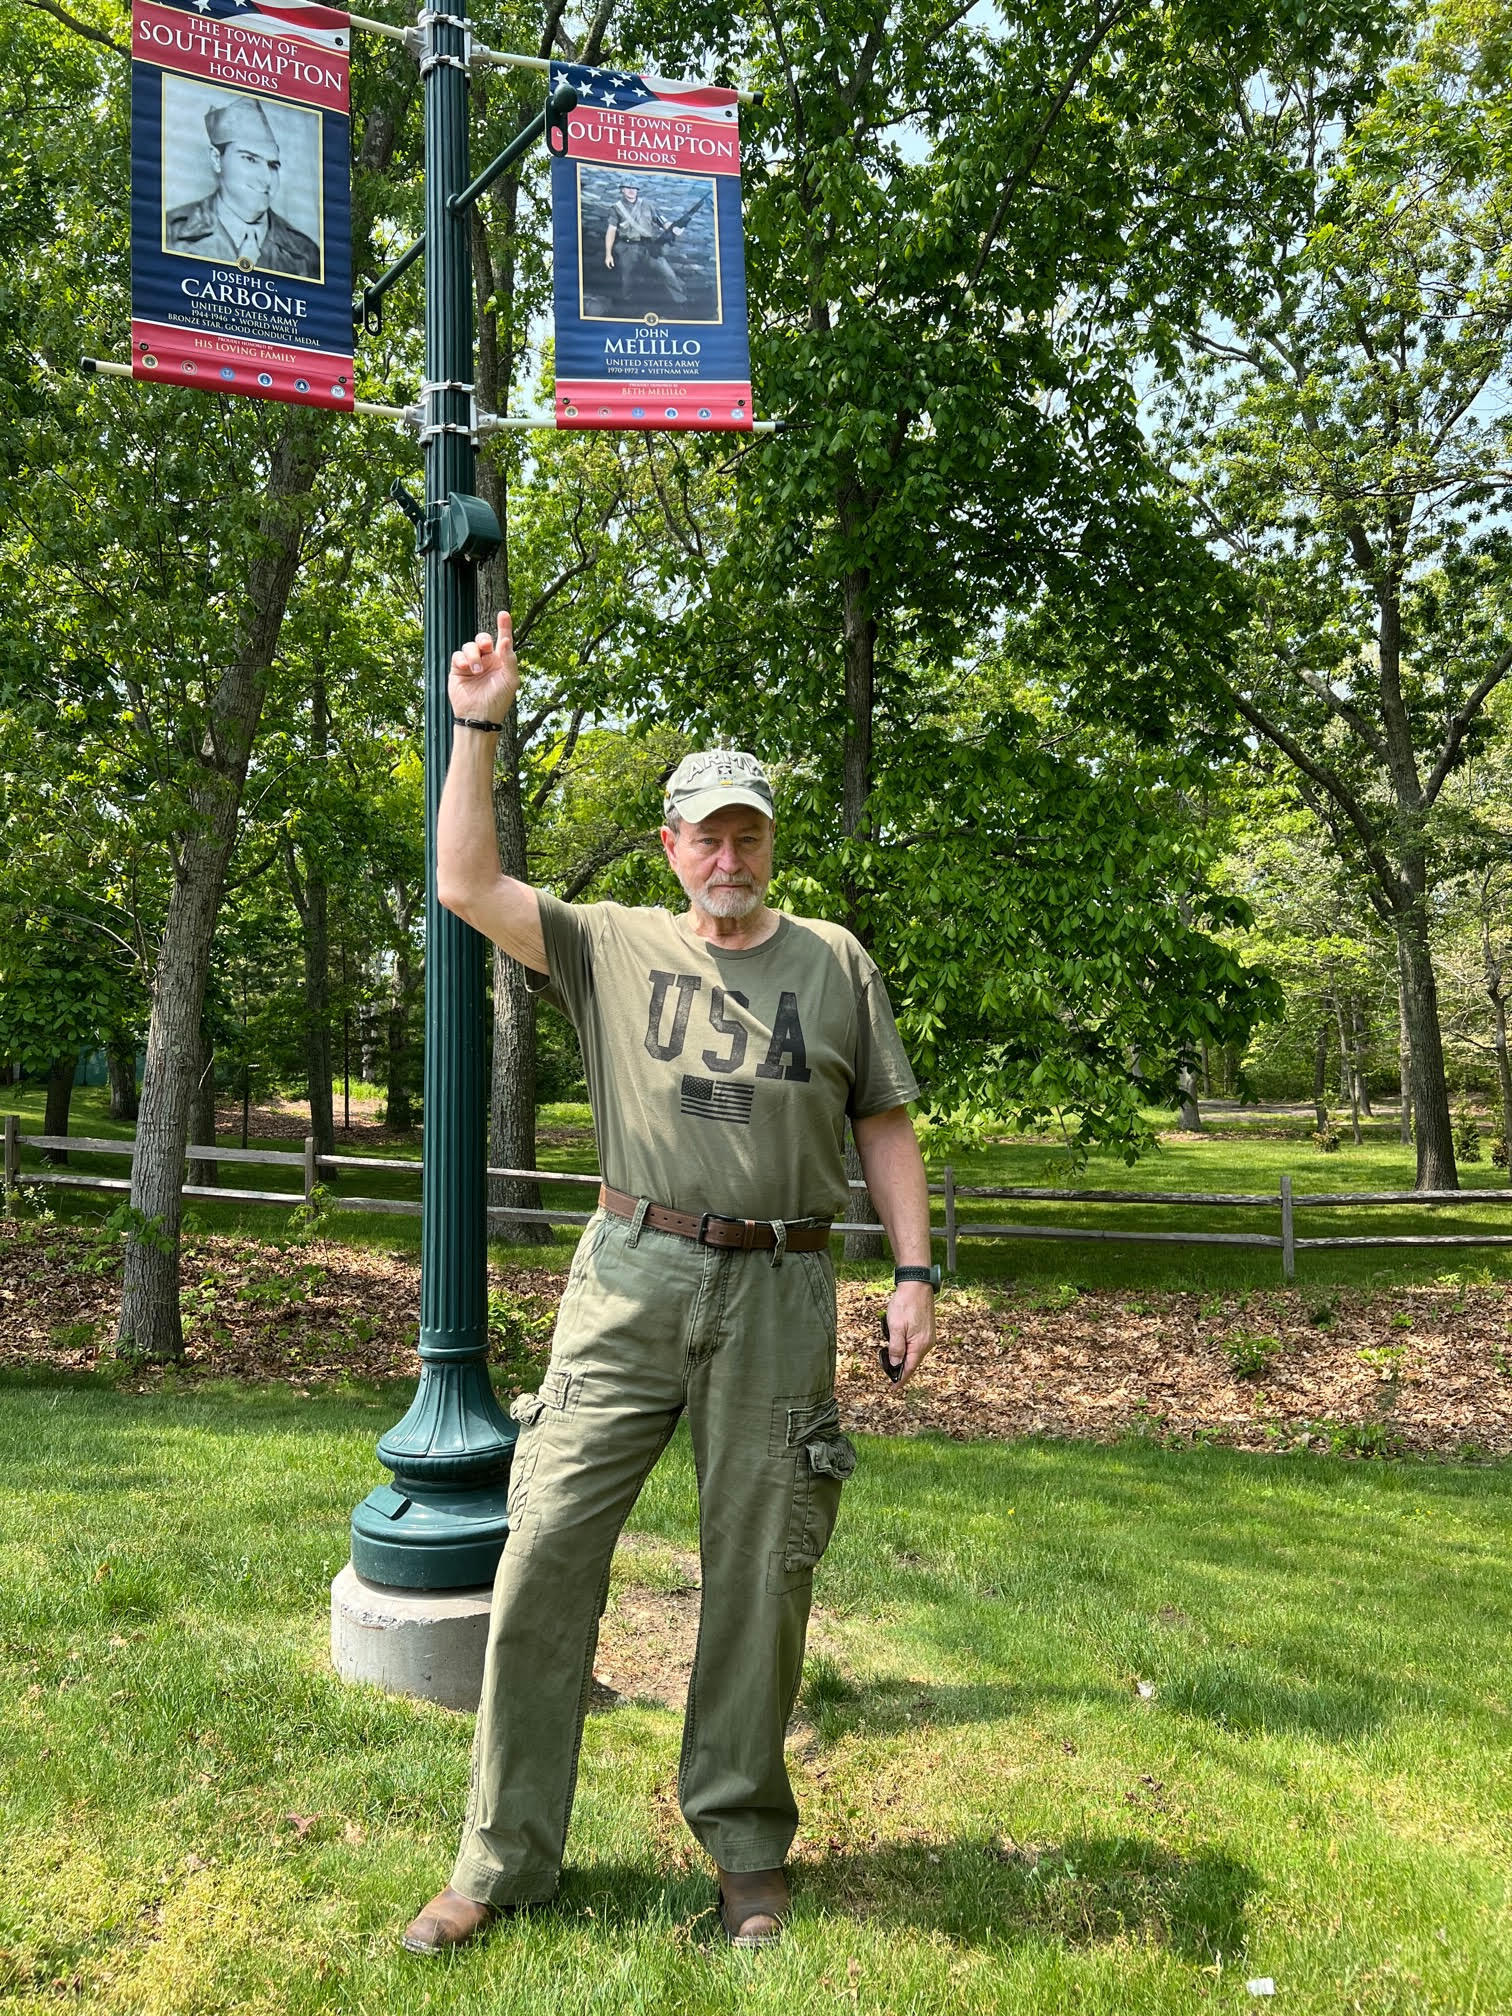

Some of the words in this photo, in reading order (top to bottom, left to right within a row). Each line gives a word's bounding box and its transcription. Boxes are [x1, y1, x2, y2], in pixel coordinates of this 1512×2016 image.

[188, 16, 220, 36] THE
[224, 27, 273, 50] TOWN
[278, 42, 298, 57] OF
[140, 20, 343, 92] SOUTHAMPTON
[209, 62, 278, 90] HONORS
[598, 112, 625, 126] THE
[629, 116, 671, 131] TOWN
[676, 122, 693, 134] OF
[557, 121, 733, 158] OUTHAMPTON
[617, 148, 677, 164] HONORS
[212, 270, 262, 289] JOSEPH
[266, 280, 278, 293] C.
[181, 278, 308, 318] CARBONE
[192, 300, 232, 315] UNITED
[235, 308, 268, 322] STATES
[270, 314, 299, 328] ARMY
[192, 310, 228, 322] 1944-1946
[239, 318, 270, 330] WORLD
[272, 325, 290, 334] WAR
[168, 312, 200, 325] BRONZE
[225, 323, 250, 334] GOOD
[252, 328, 292, 342] CONDUCT
[294, 337, 320, 347] MEDAL
[634, 328, 669, 340] JOHN
[194, 338, 212, 350] HIS
[216, 342, 256, 358] LOVING
[260, 351, 296, 364] FAMILY
[604, 338, 700, 356] MELILLO
[606, 358, 642, 366] UNITED
[622, 387, 646, 396] BETH
[648, 388, 687, 396] MELILLO
[687, 750, 762, 783] ARMY
[644, 969, 812, 1083] USA
